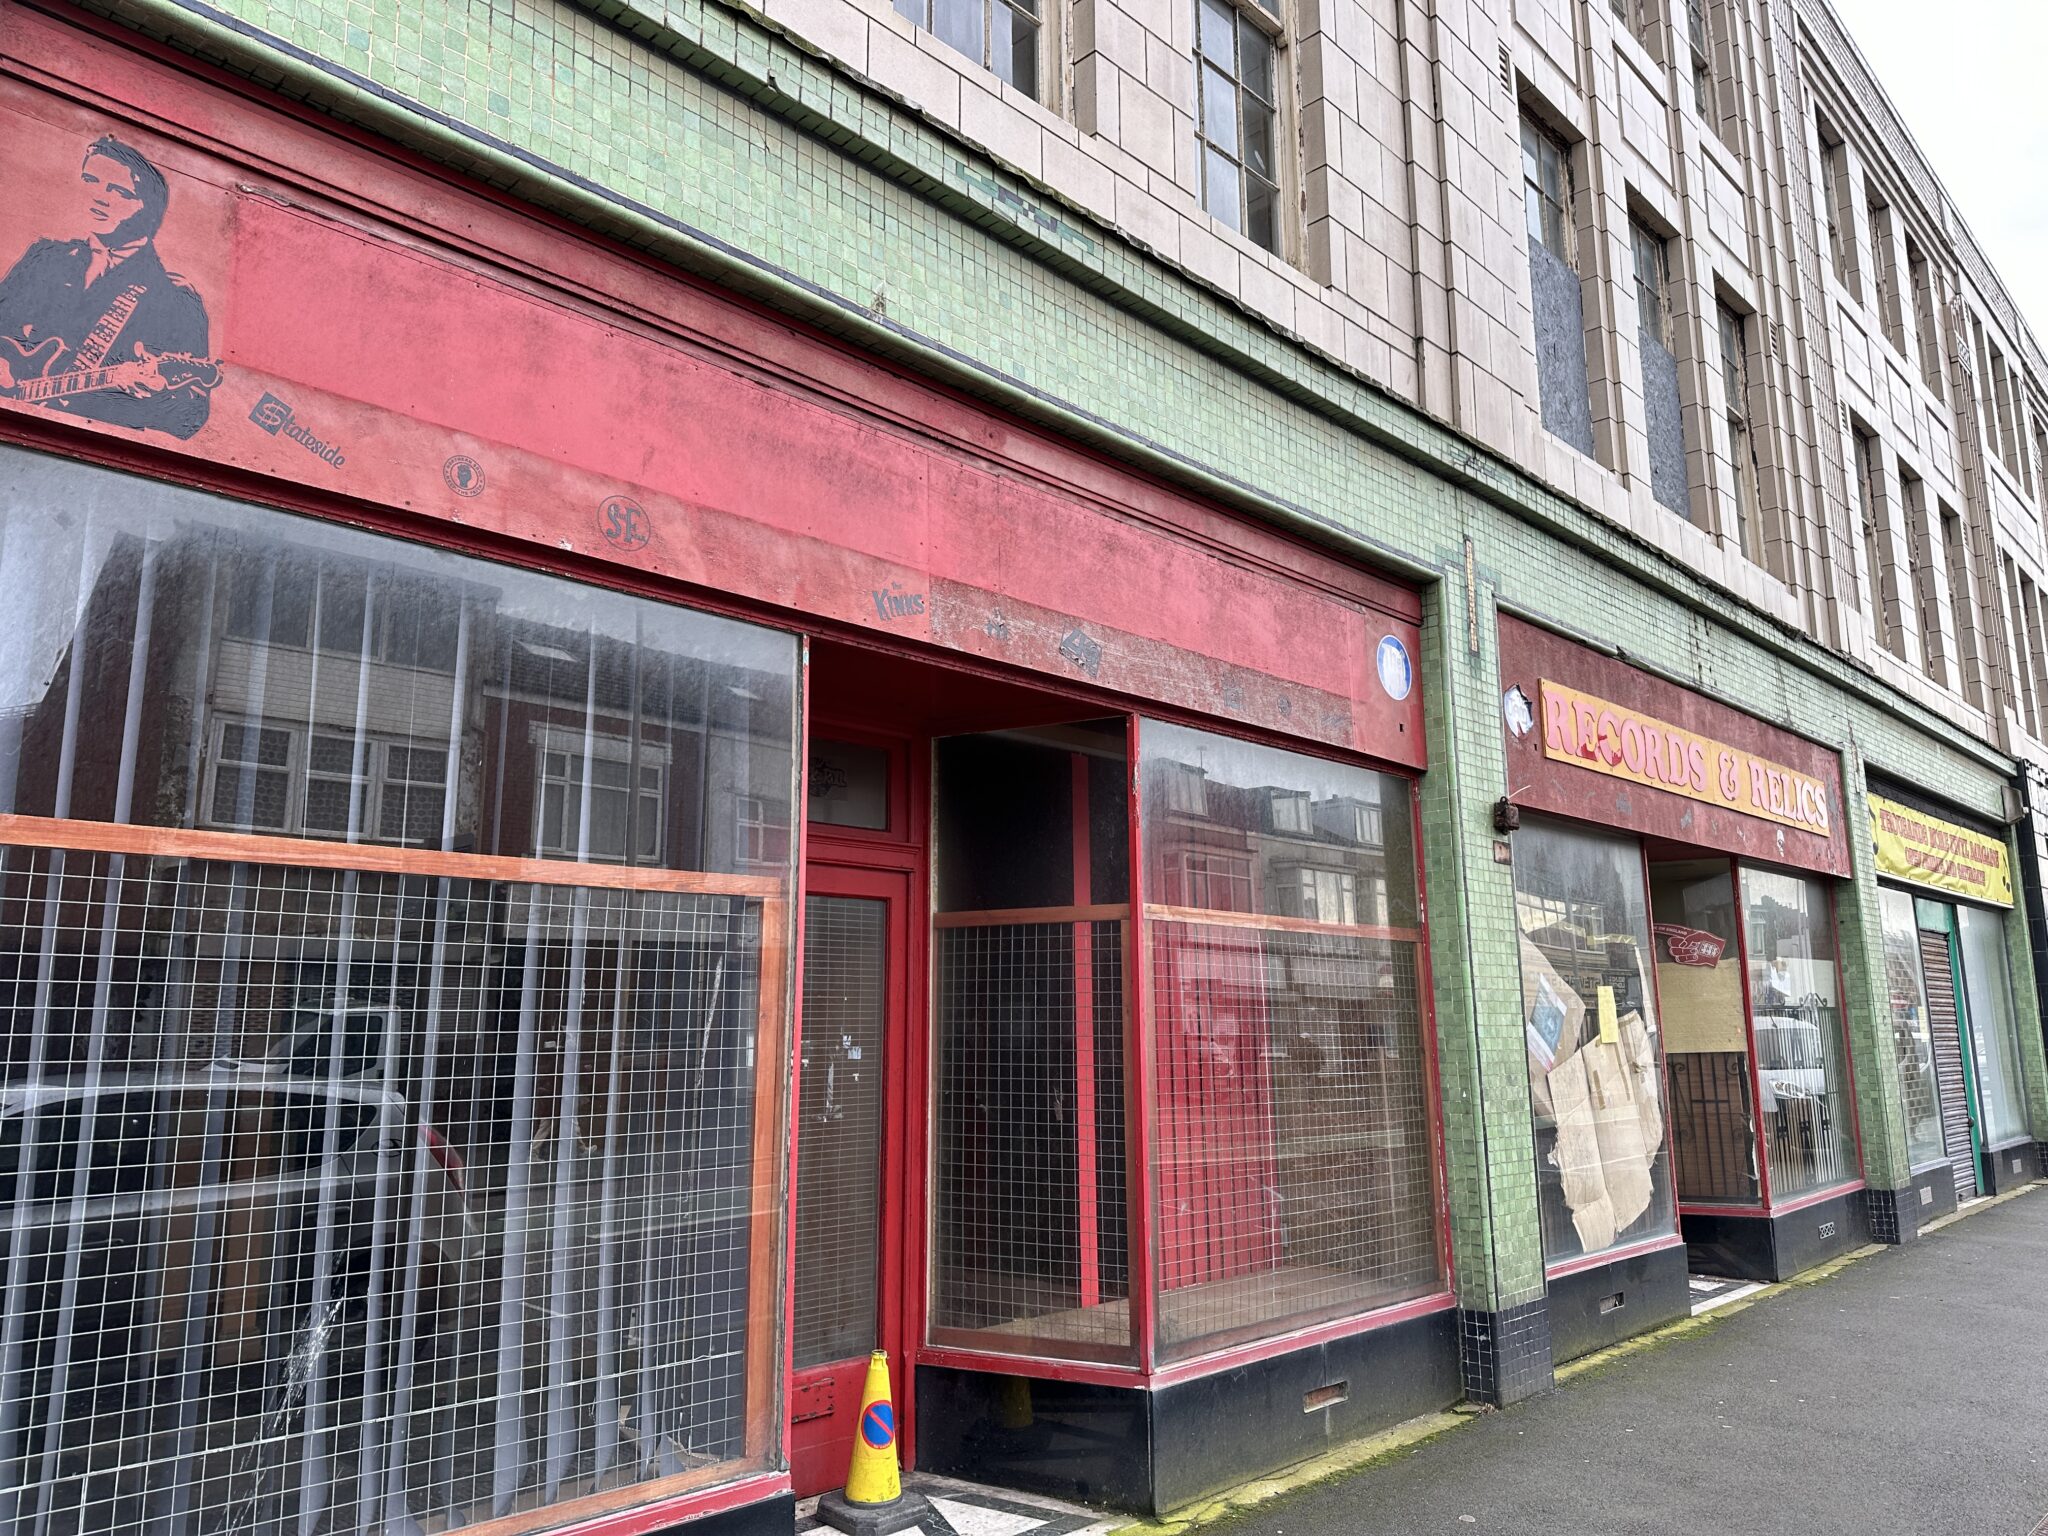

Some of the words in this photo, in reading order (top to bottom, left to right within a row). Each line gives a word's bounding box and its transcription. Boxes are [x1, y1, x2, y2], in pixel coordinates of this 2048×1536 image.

[253, 398, 345, 469] Stateside
[1542, 690, 1708, 793] RECORDS
[1718, 751, 1740, 801] &
[1749, 759, 1828, 829] RELICS
